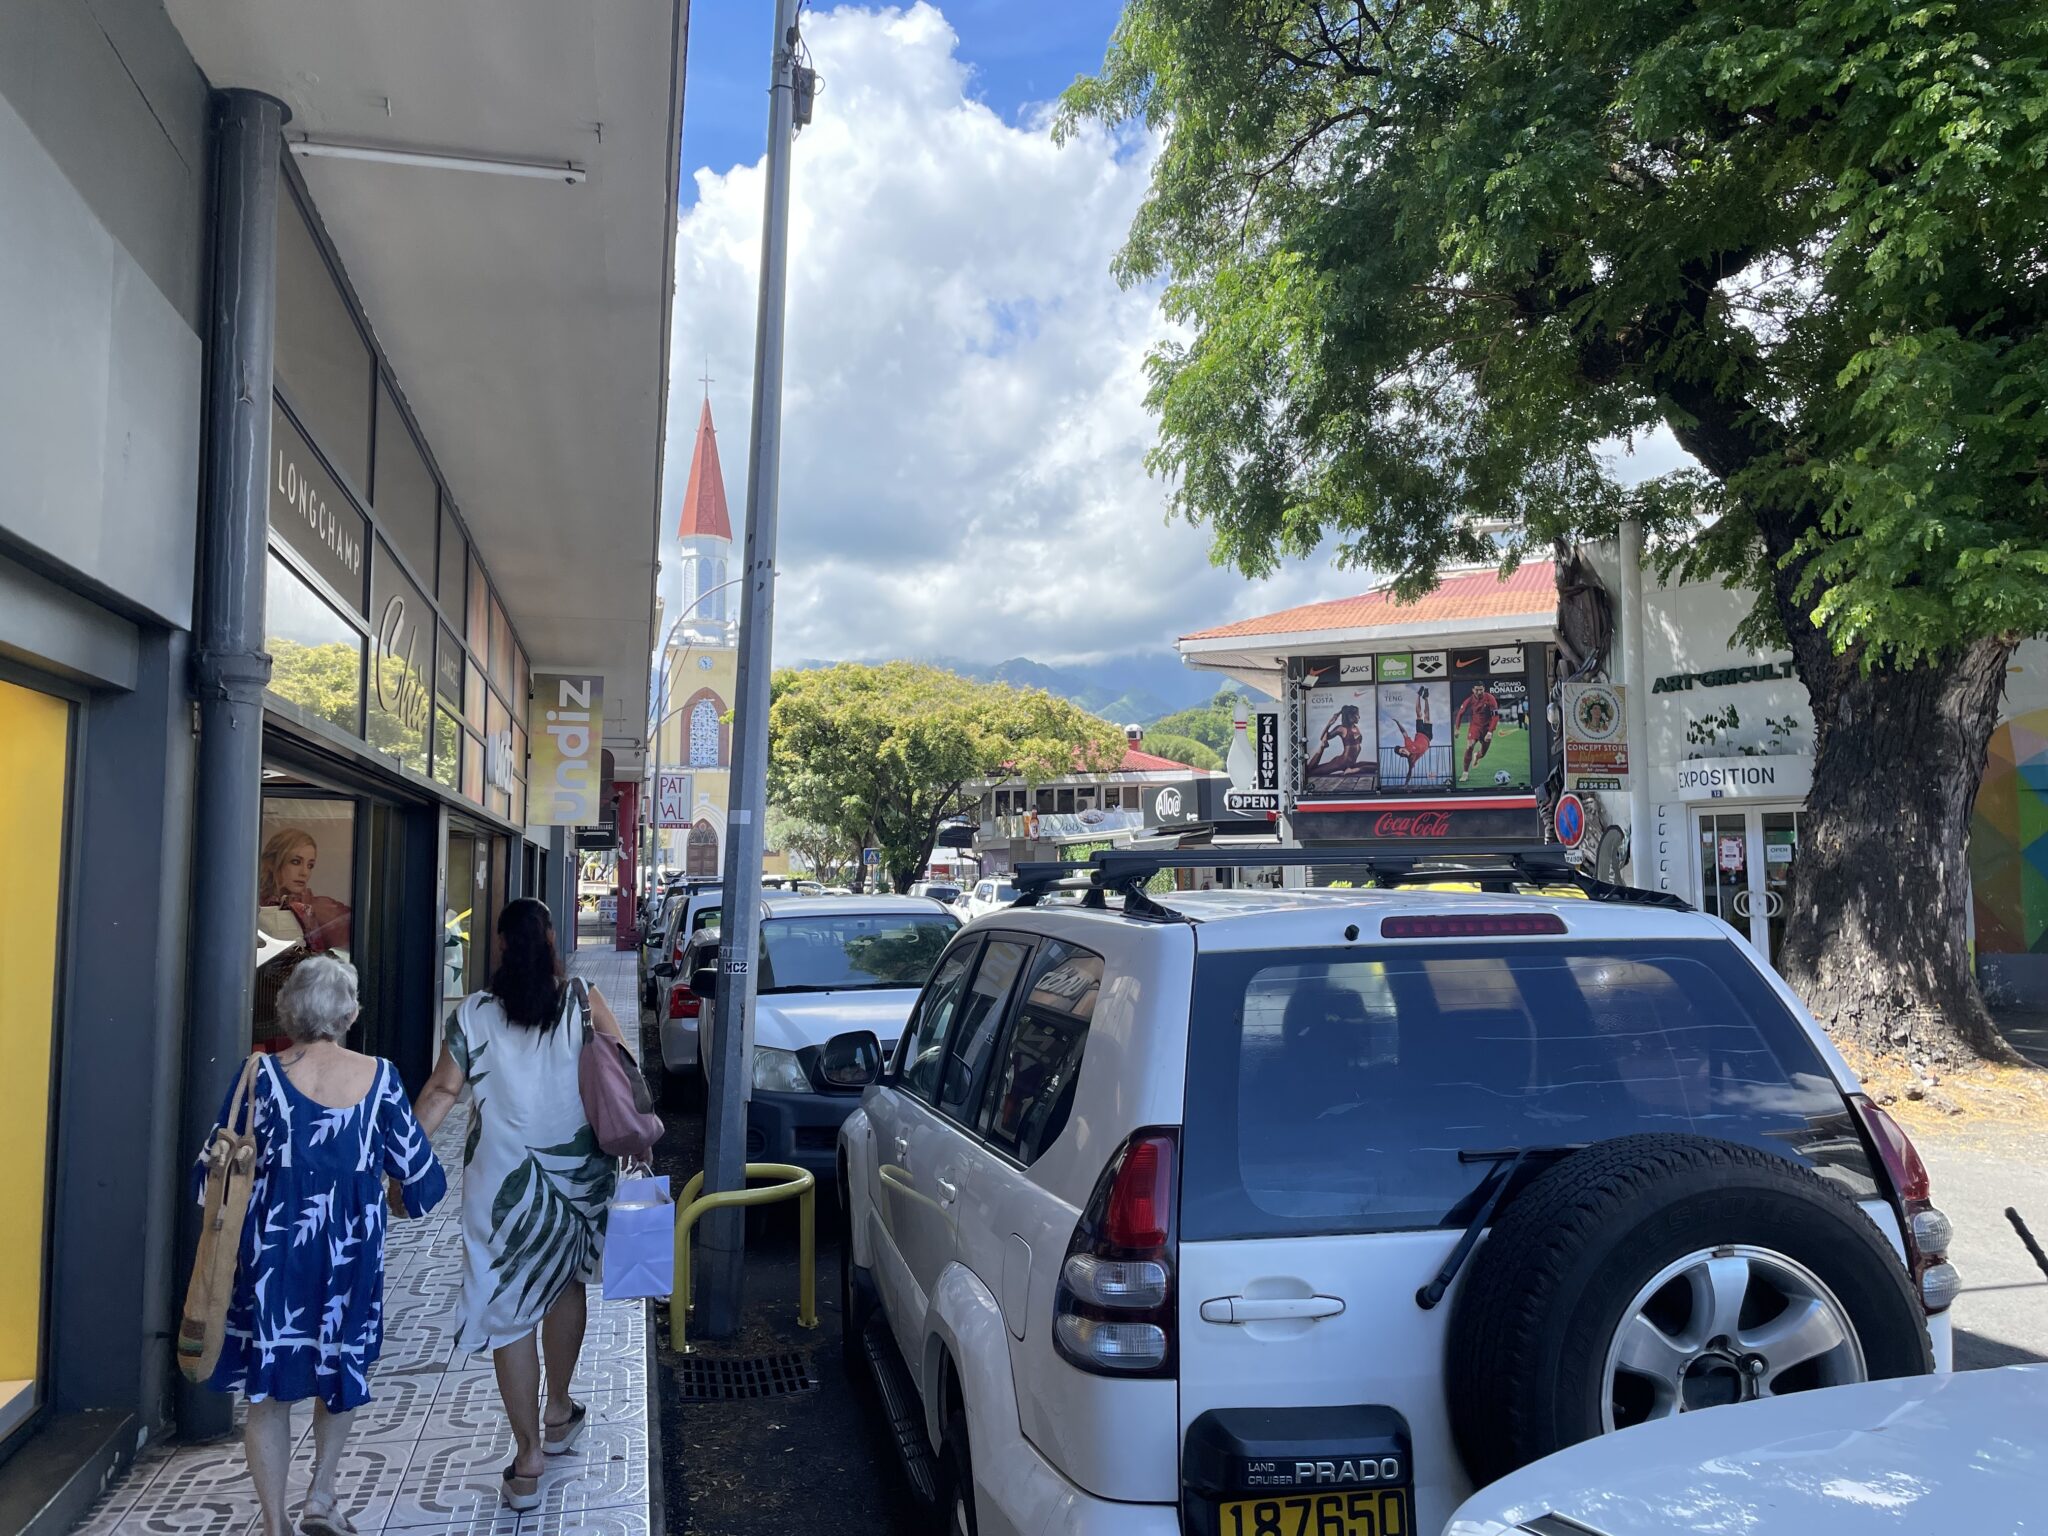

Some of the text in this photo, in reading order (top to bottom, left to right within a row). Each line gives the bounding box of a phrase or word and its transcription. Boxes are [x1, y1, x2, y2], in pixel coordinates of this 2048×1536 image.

[278, 449, 360, 576] LONGCHAMP
[1350, 664, 1370, 673] asics
[1500, 656, 1522, 665] asics
[1489, 685, 1526, 694] RONALDO
[546, 679, 591, 822] undiz
[1261, 716, 1275, 788] ZIONBOWL
[1567, 744, 1627, 752] CONCEPT STORE
[659, 776, 686, 800] PAT
[1679, 767, 1775, 788] EXPOSITION
[659, 796, 685, 820] VAL
[1230, 795, 1269, 808] OPEN
[1247, 1457, 1399, 1484] LAND PRADO
[1247, 1475, 1293, 1485] CRUISER
[1229, 1490, 1407, 1536] 187650
